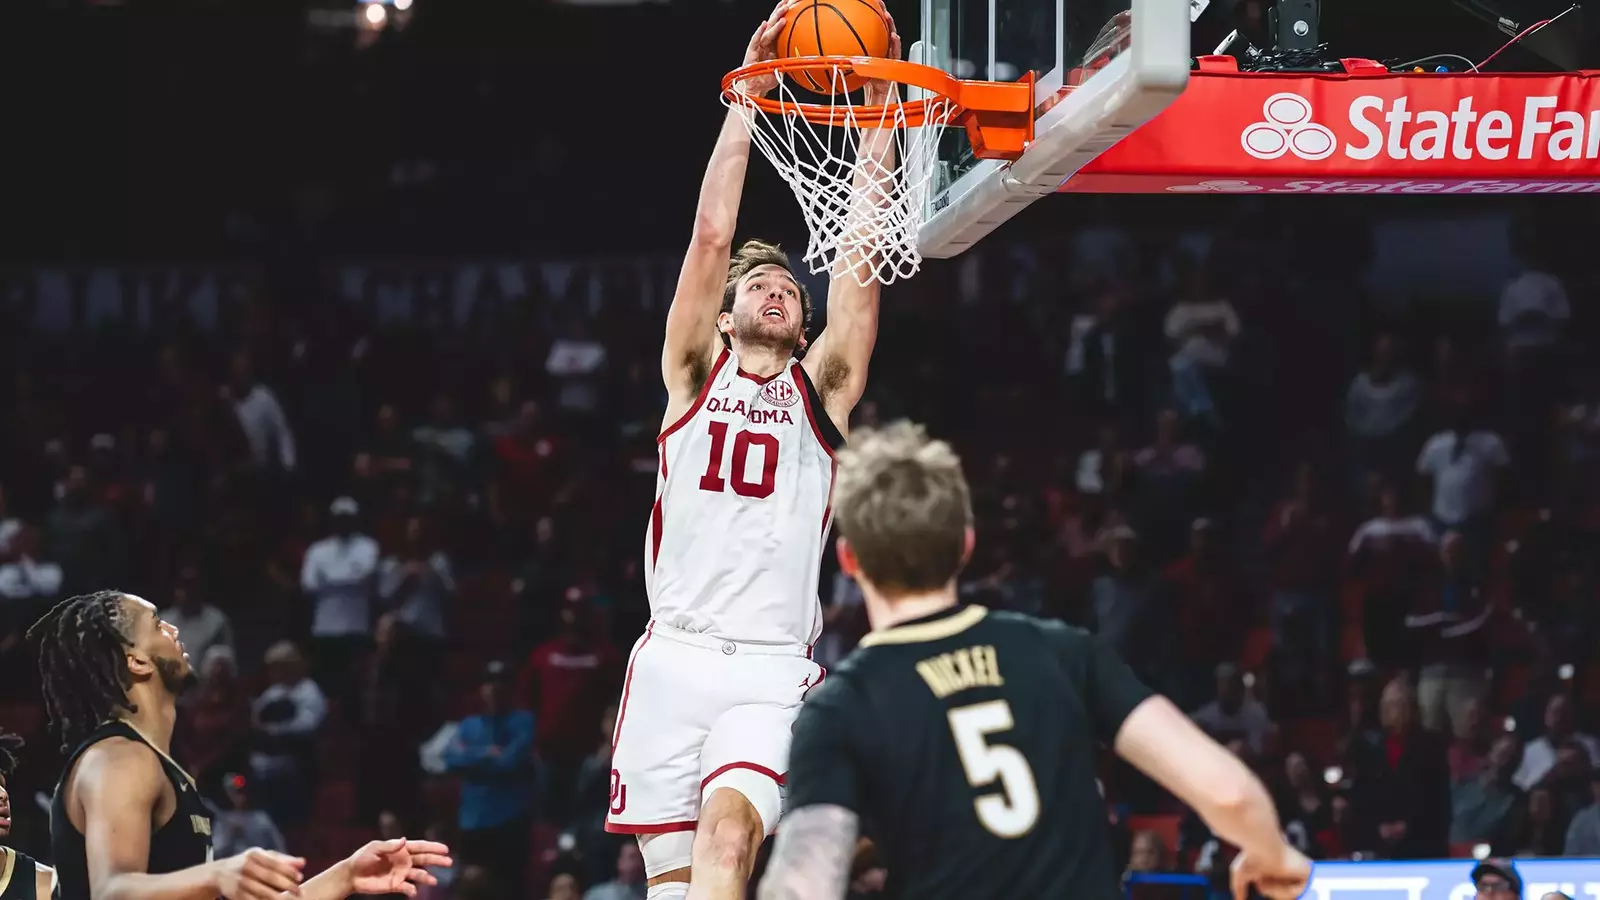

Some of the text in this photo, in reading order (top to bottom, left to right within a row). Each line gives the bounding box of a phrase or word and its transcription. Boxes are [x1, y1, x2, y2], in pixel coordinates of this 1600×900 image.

[706, 397, 794, 425] OLAOMA
[767, 381, 792, 400] SEC
[699, 420, 779, 499] 10
[947, 699, 1040, 839] 5
